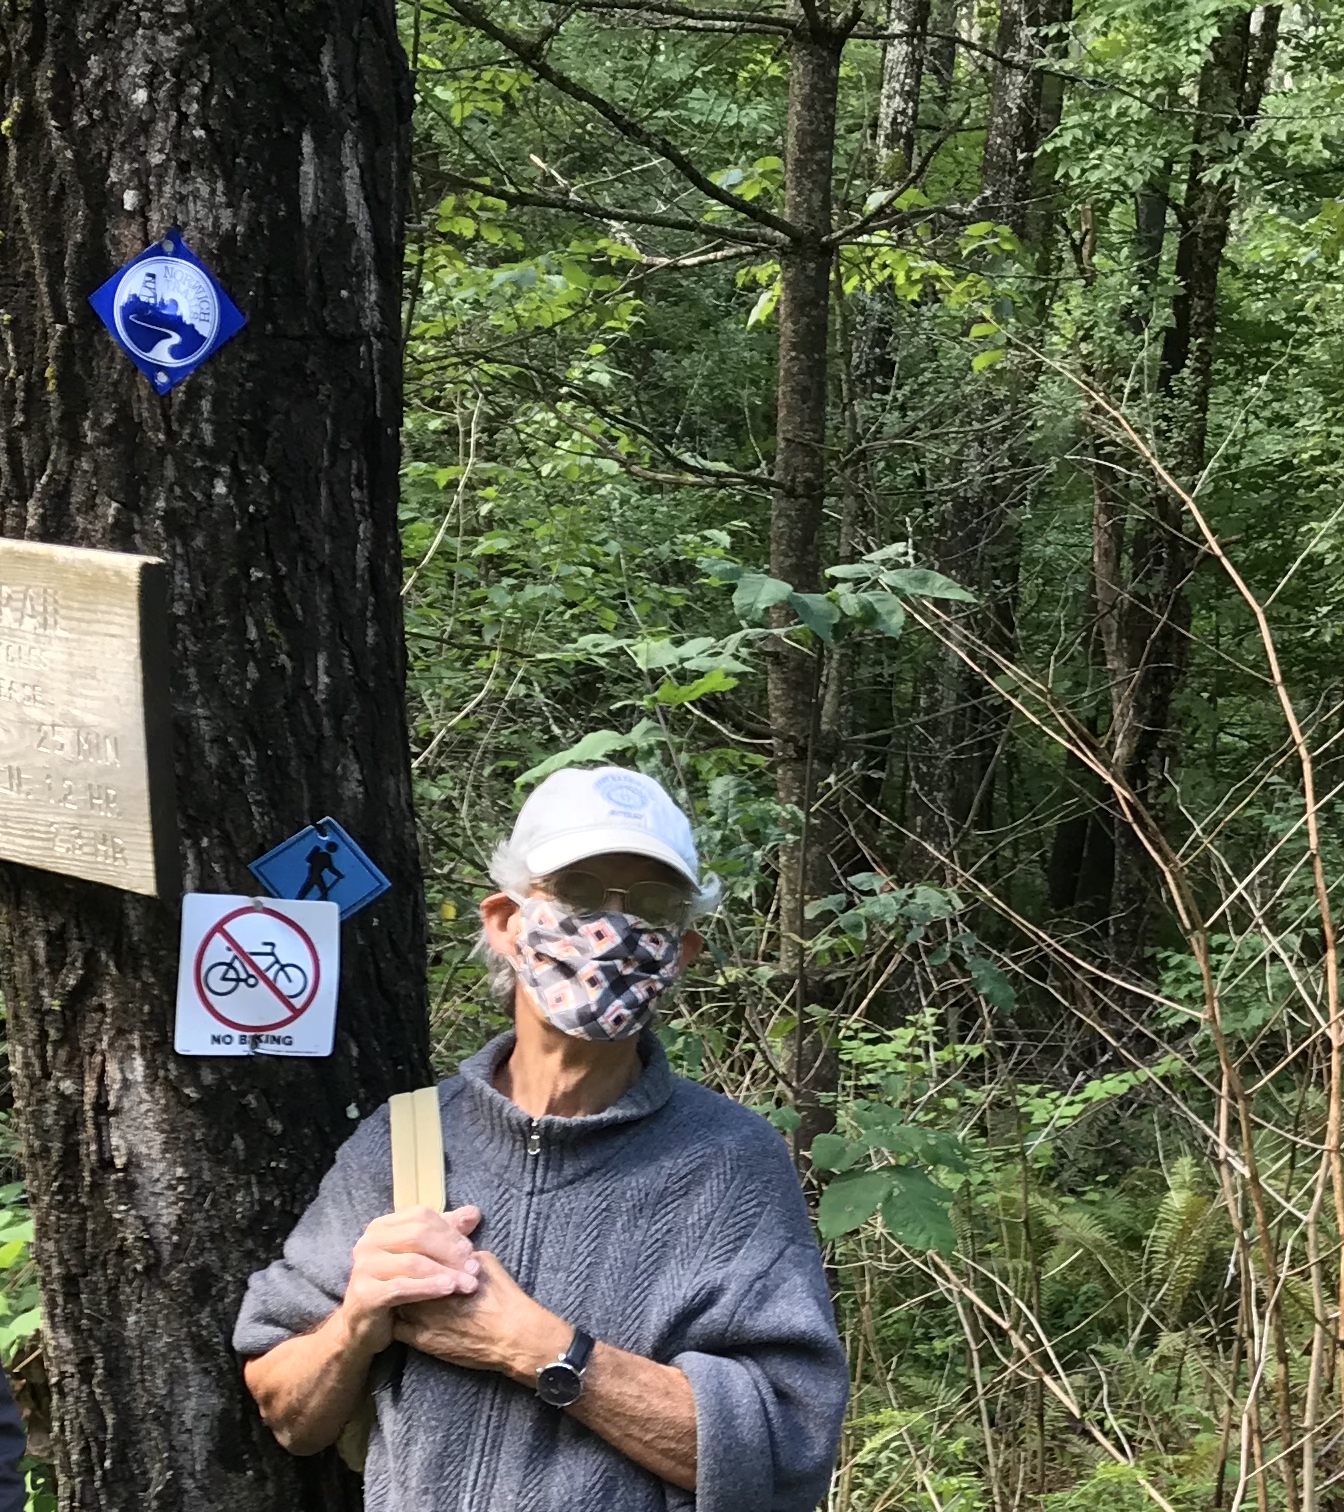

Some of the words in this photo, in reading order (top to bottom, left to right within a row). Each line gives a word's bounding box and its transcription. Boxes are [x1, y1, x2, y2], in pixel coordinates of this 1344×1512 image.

[163, 266, 210, 322] NORWICH
[37, 723, 66, 755] 25
[210, 1034, 233, 1046] NO
